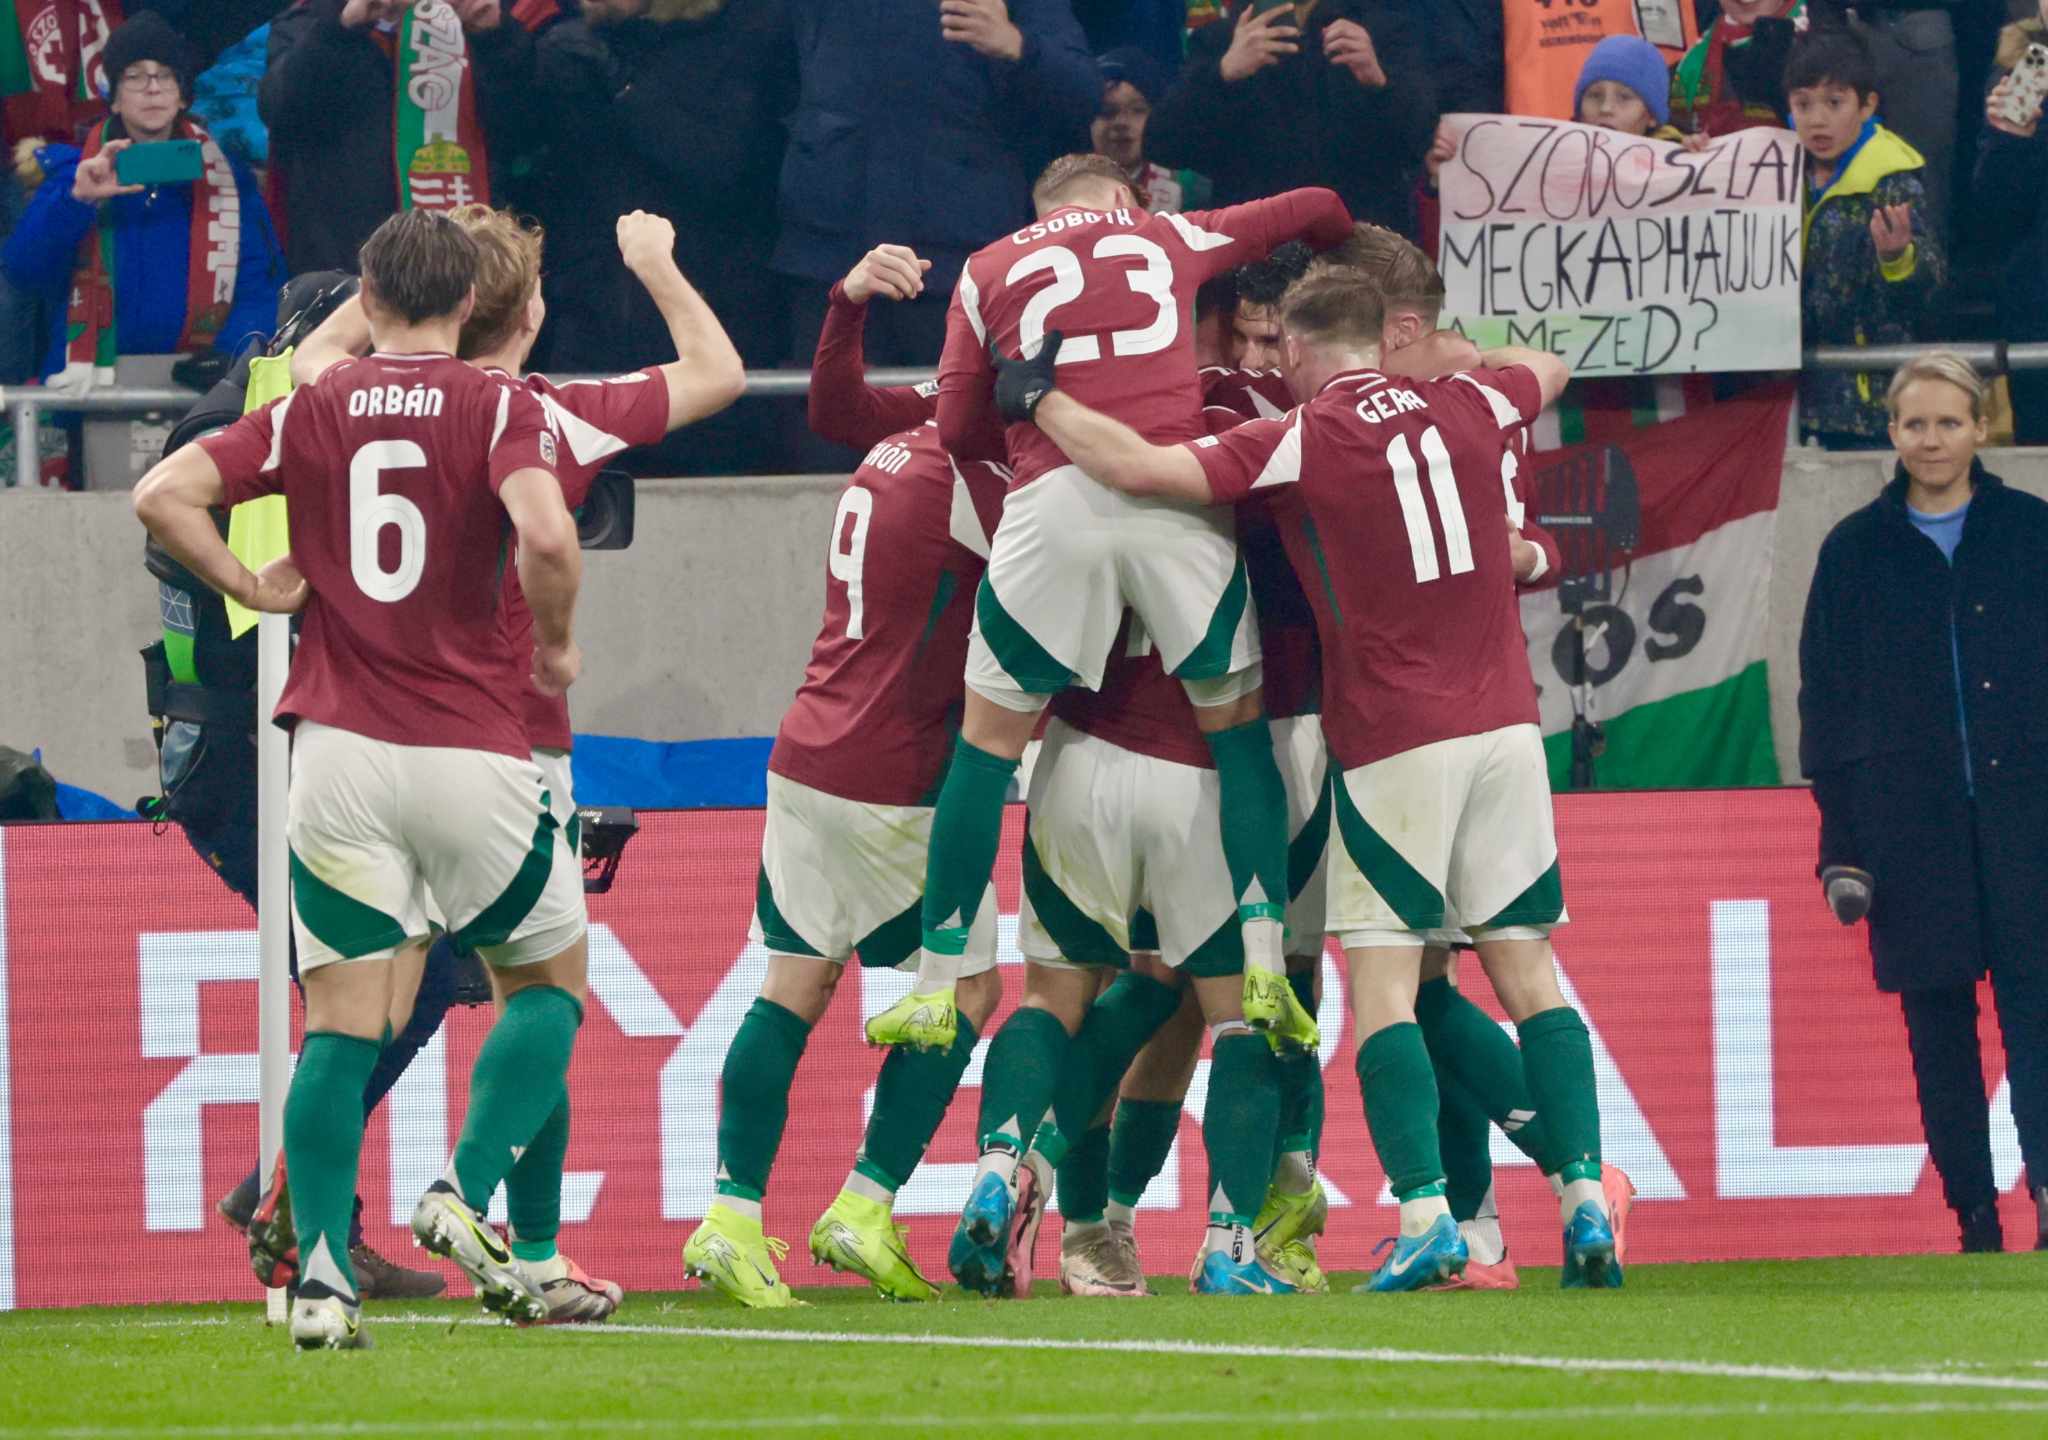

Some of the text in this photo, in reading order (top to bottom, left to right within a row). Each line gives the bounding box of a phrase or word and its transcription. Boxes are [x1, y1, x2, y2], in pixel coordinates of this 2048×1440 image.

[1455, 121, 1802, 220] SZOBOSZLAI
[1006, 234, 1178, 365] 23
[1441, 209, 1800, 316] MEGKAPHATJUK
[349, 383, 444, 418] ORBÁN
[349, 439, 428, 603] 6
[829, 486, 873, 640] 9
[1386, 425, 1475, 584] 11
